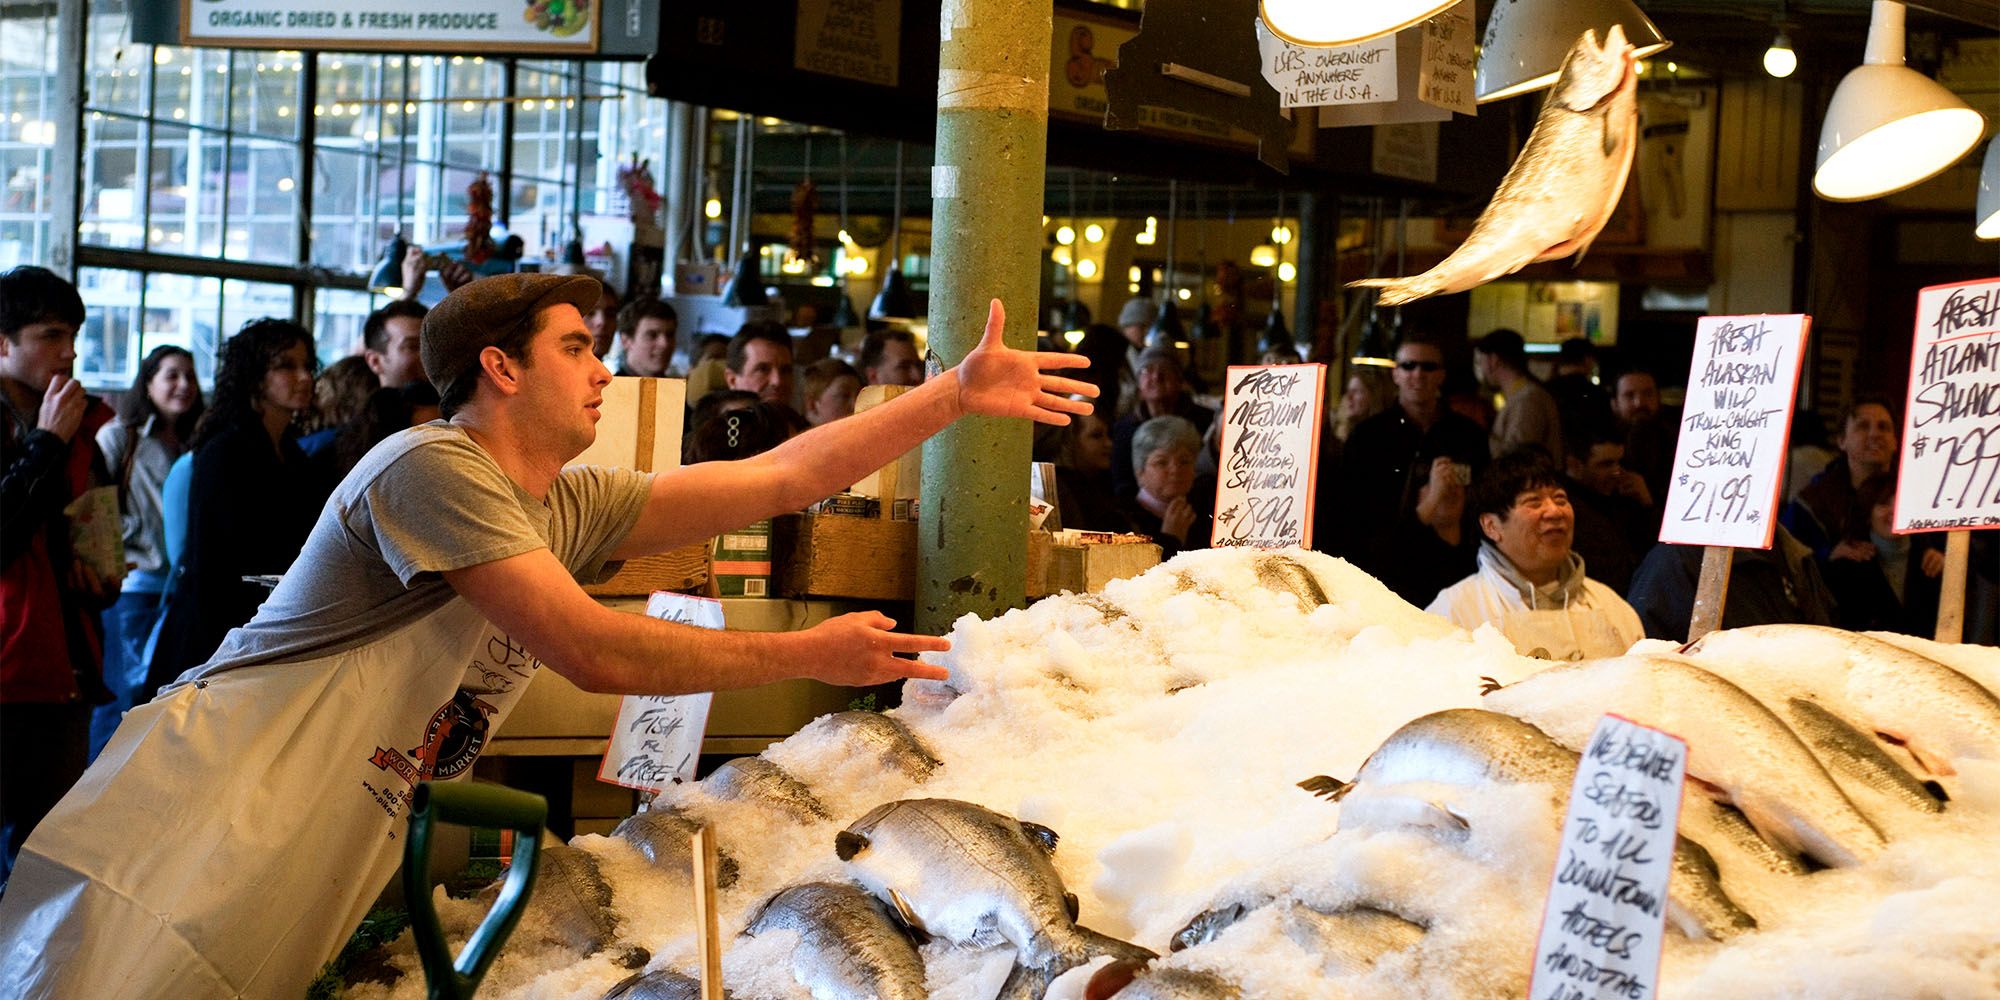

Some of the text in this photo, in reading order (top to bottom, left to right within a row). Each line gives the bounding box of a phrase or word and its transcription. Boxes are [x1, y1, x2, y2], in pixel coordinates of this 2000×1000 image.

[208, 10, 498, 31] ORGANIC DRIED & FRESH PRODUCE
[1296, 68, 1364, 87] ANYWHERE
[1302, 87, 1331, 104] THE
[1708, 320, 1773, 358] FRESH
[1700, 346, 1783, 388] ALASKAN
[1233, 369, 1300, 400] FRESH
[1713, 387, 1757, 410] WILD
[1229, 399, 1307, 429] MEDIUM
[1233, 427, 1283, 457] KING
[1686, 437, 1759, 469] SALMON
[1706, 430, 1741, 451] KING
[1226, 467, 1299, 493] SALMON
[631, 708, 684, 738] FISH
[390, 751, 417, 783] WORL
[439, 736, 481, 776] MARKET
[1576, 817, 1653, 864] TO ALL
[1557, 849, 1660, 918] DOWNTOWN
[1561, 900, 1642, 960] HOTELS
